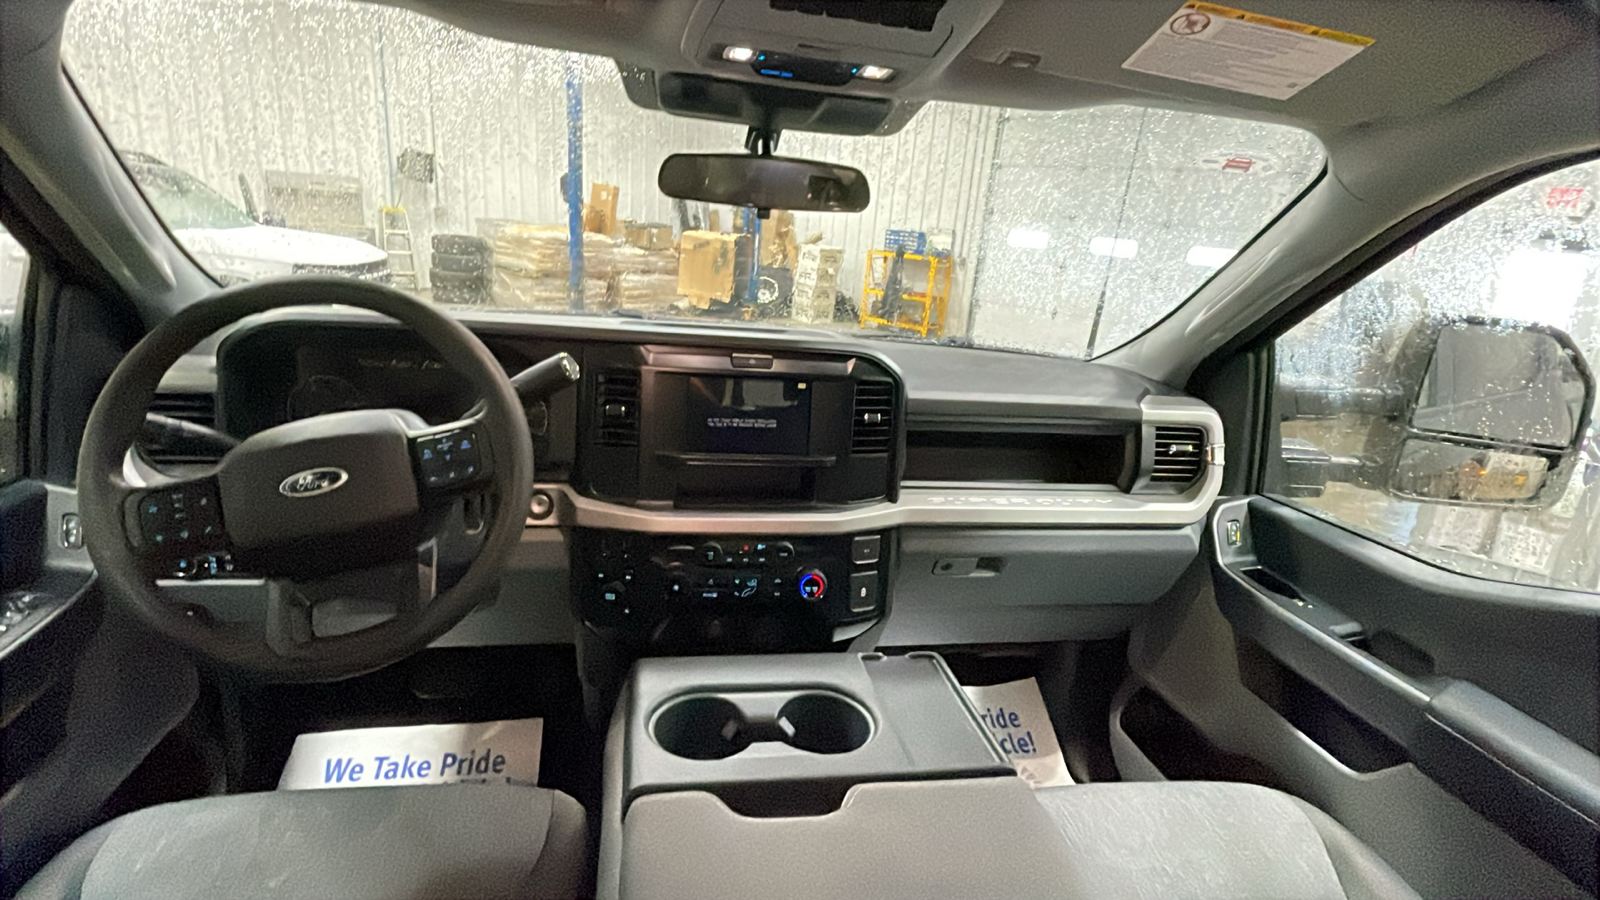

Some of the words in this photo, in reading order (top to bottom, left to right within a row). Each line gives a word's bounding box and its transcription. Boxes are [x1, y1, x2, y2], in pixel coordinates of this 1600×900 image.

[296, 473, 330, 491] Ford
[980, 707, 1021, 729] ride
[999, 730, 1037, 755] cle!
[323, 757, 364, 784] We
[373, 754, 431, 780] Take
[439, 748, 506, 777] Pride
